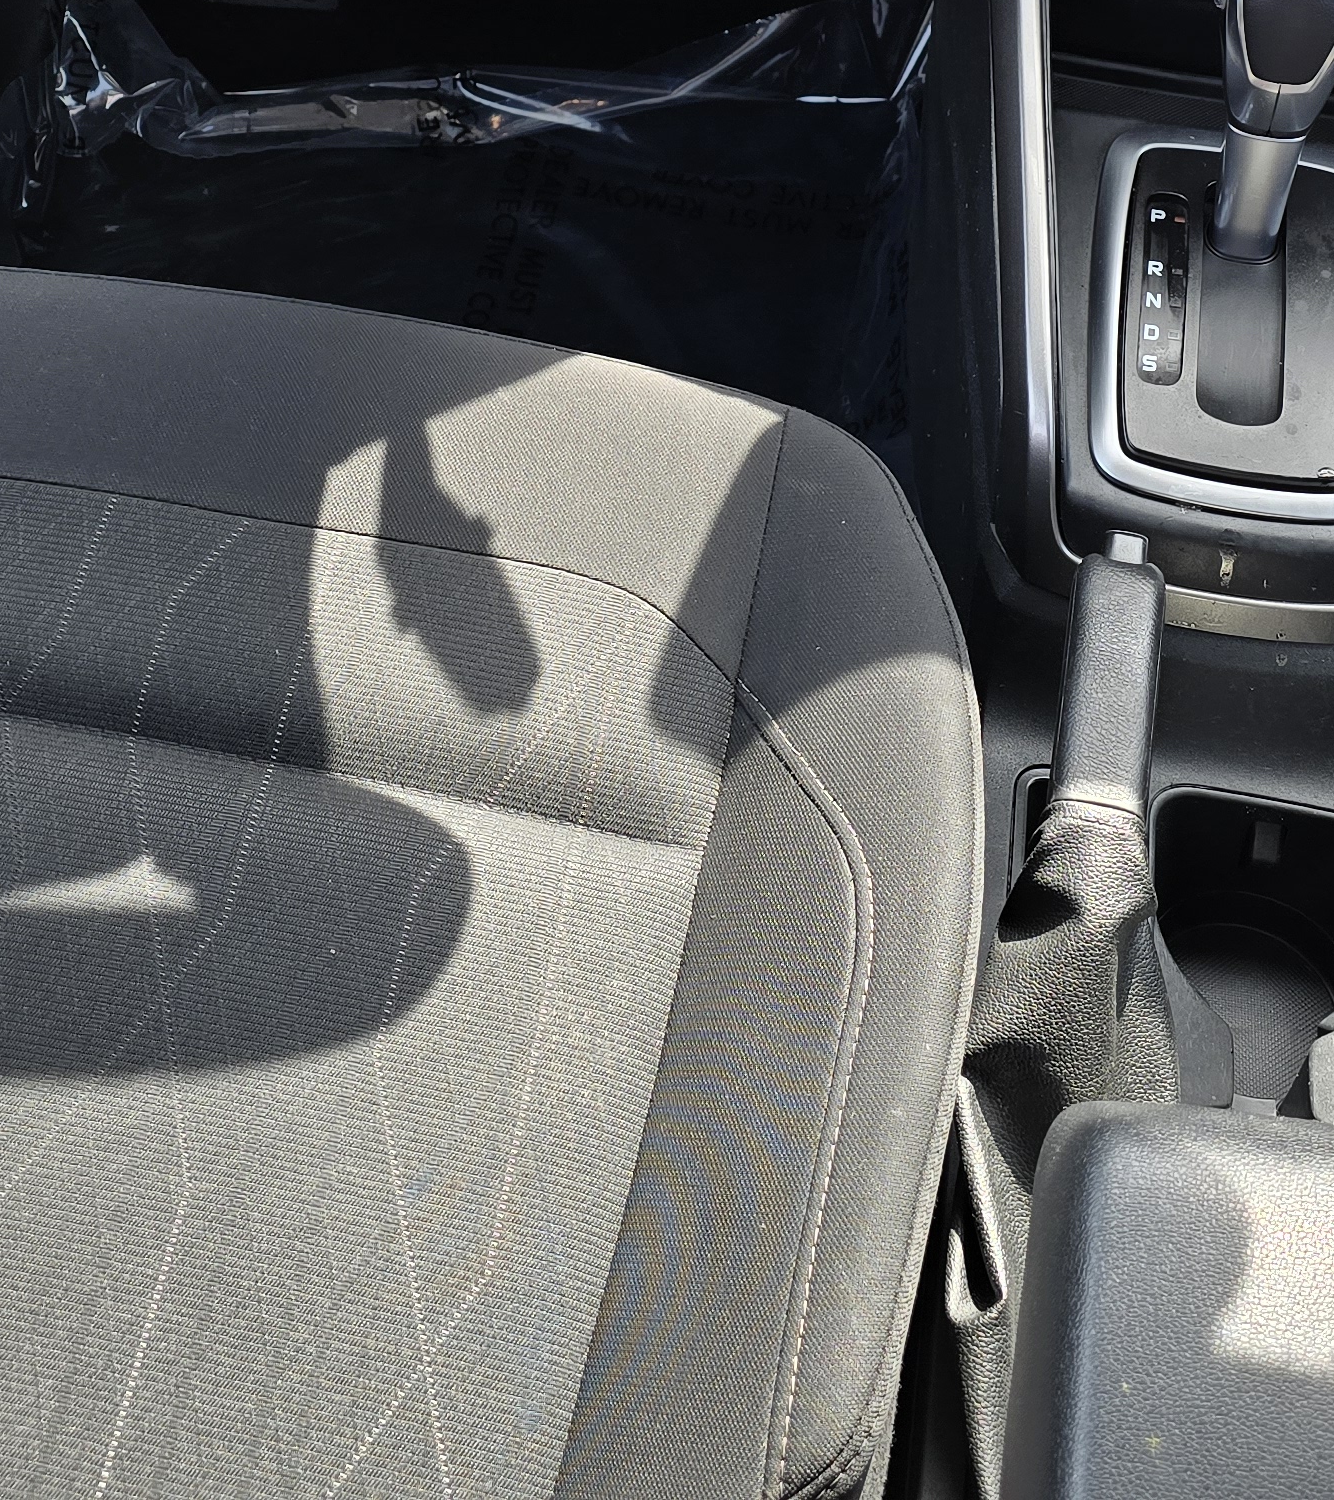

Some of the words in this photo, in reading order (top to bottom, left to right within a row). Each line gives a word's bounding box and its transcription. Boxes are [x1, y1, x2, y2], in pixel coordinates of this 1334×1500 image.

[1150, 208, 1166, 222] P
[1148, 261, 1163, 275] R
[1146, 293, 1162, 308] N
[1143, 324, 1159, 340] D
[1142, 356, 1158, 371] S
